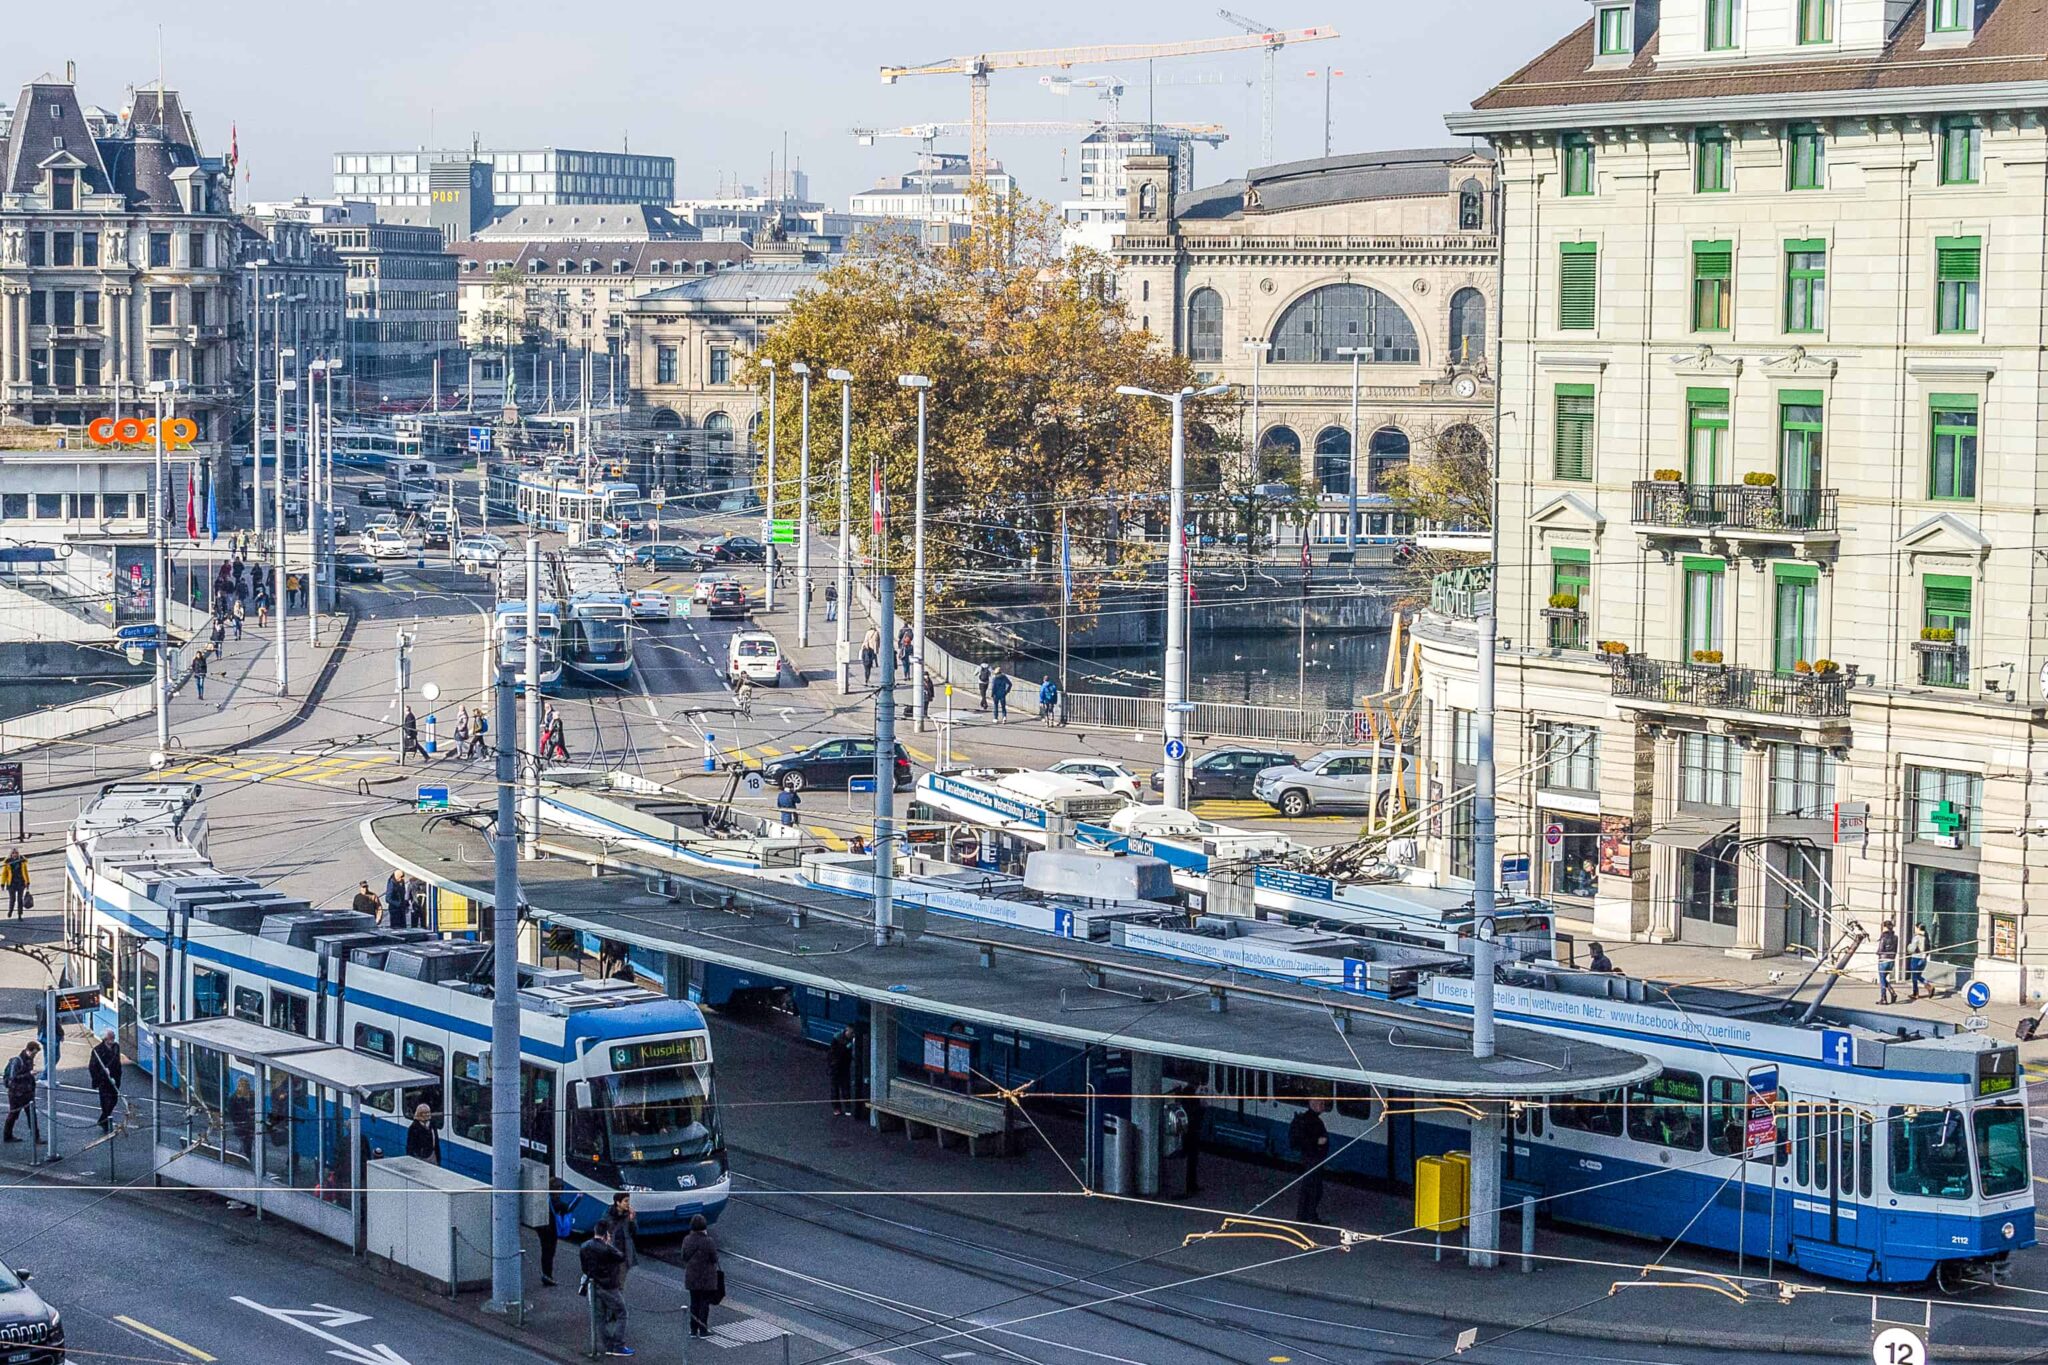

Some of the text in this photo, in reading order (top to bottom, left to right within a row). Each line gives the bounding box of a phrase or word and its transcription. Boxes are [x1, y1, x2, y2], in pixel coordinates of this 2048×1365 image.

[433, 191, 460, 202] POST
[88, 417, 197, 451] coop
[1438, 585, 1475, 618] HOTEL
[748, 778, 760, 789] 18
[1848, 817, 1863, 828] UBS
[1438, 981, 1468, 998] Unsere
[1518, 993, 1530, 1008] im
[1531, 995, 1580, 1015] weltweiten
[1582, 1003, 1607, 1020] Netz:
[1609, 1008, 1752, 1042] www.facebook.com/zuerilinie
[615, 1049, 626, 1062] 3
[1991, 1053, 2001, 1073] 7
[1951, 1235, 1969, 1245] 2112
[1884, 1341, 1914, 1365] 12
